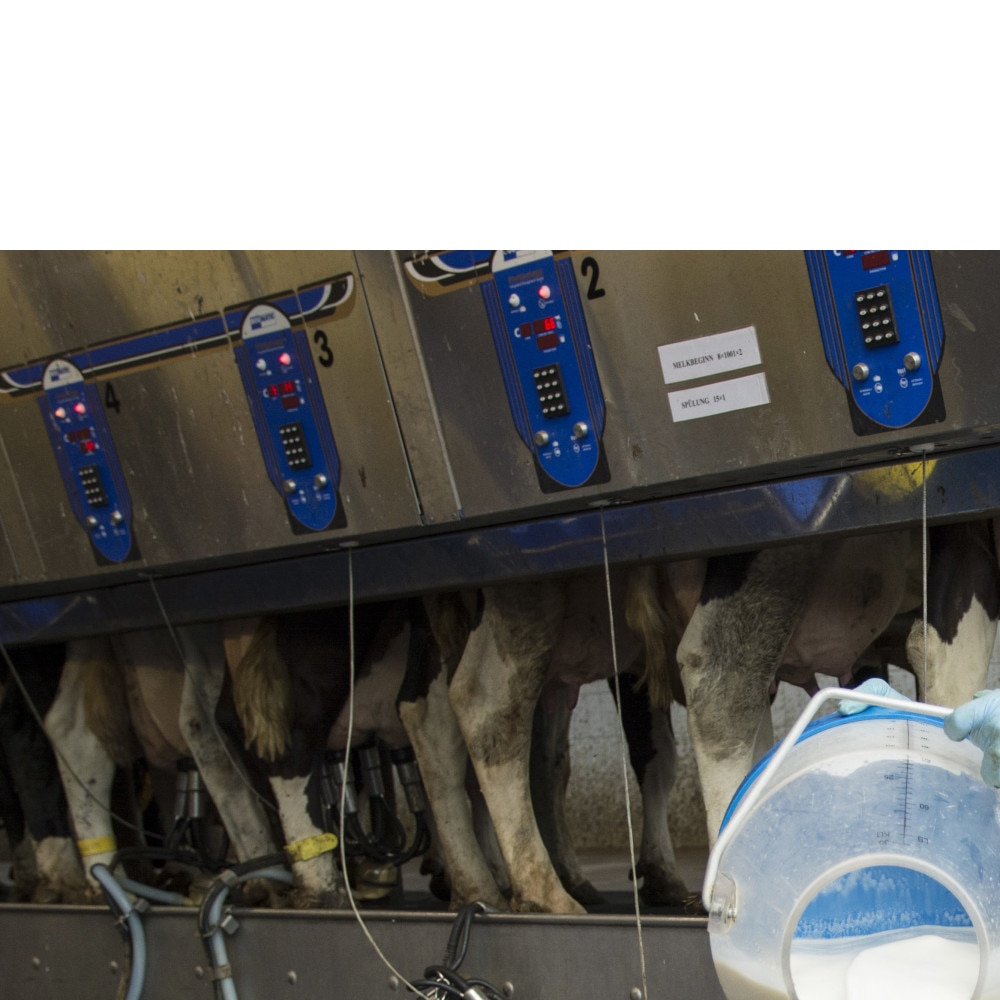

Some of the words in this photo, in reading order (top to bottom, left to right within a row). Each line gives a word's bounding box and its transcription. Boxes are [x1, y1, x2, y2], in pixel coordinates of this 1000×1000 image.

[580, 256, 606, 300] 2
[313, 329, 334, 368] 3
[672, 354, 714, 369] MELKBEGINN
[104, 381, 121, 414] 4
[681, 396, 710, 409] SPÜLUNG
